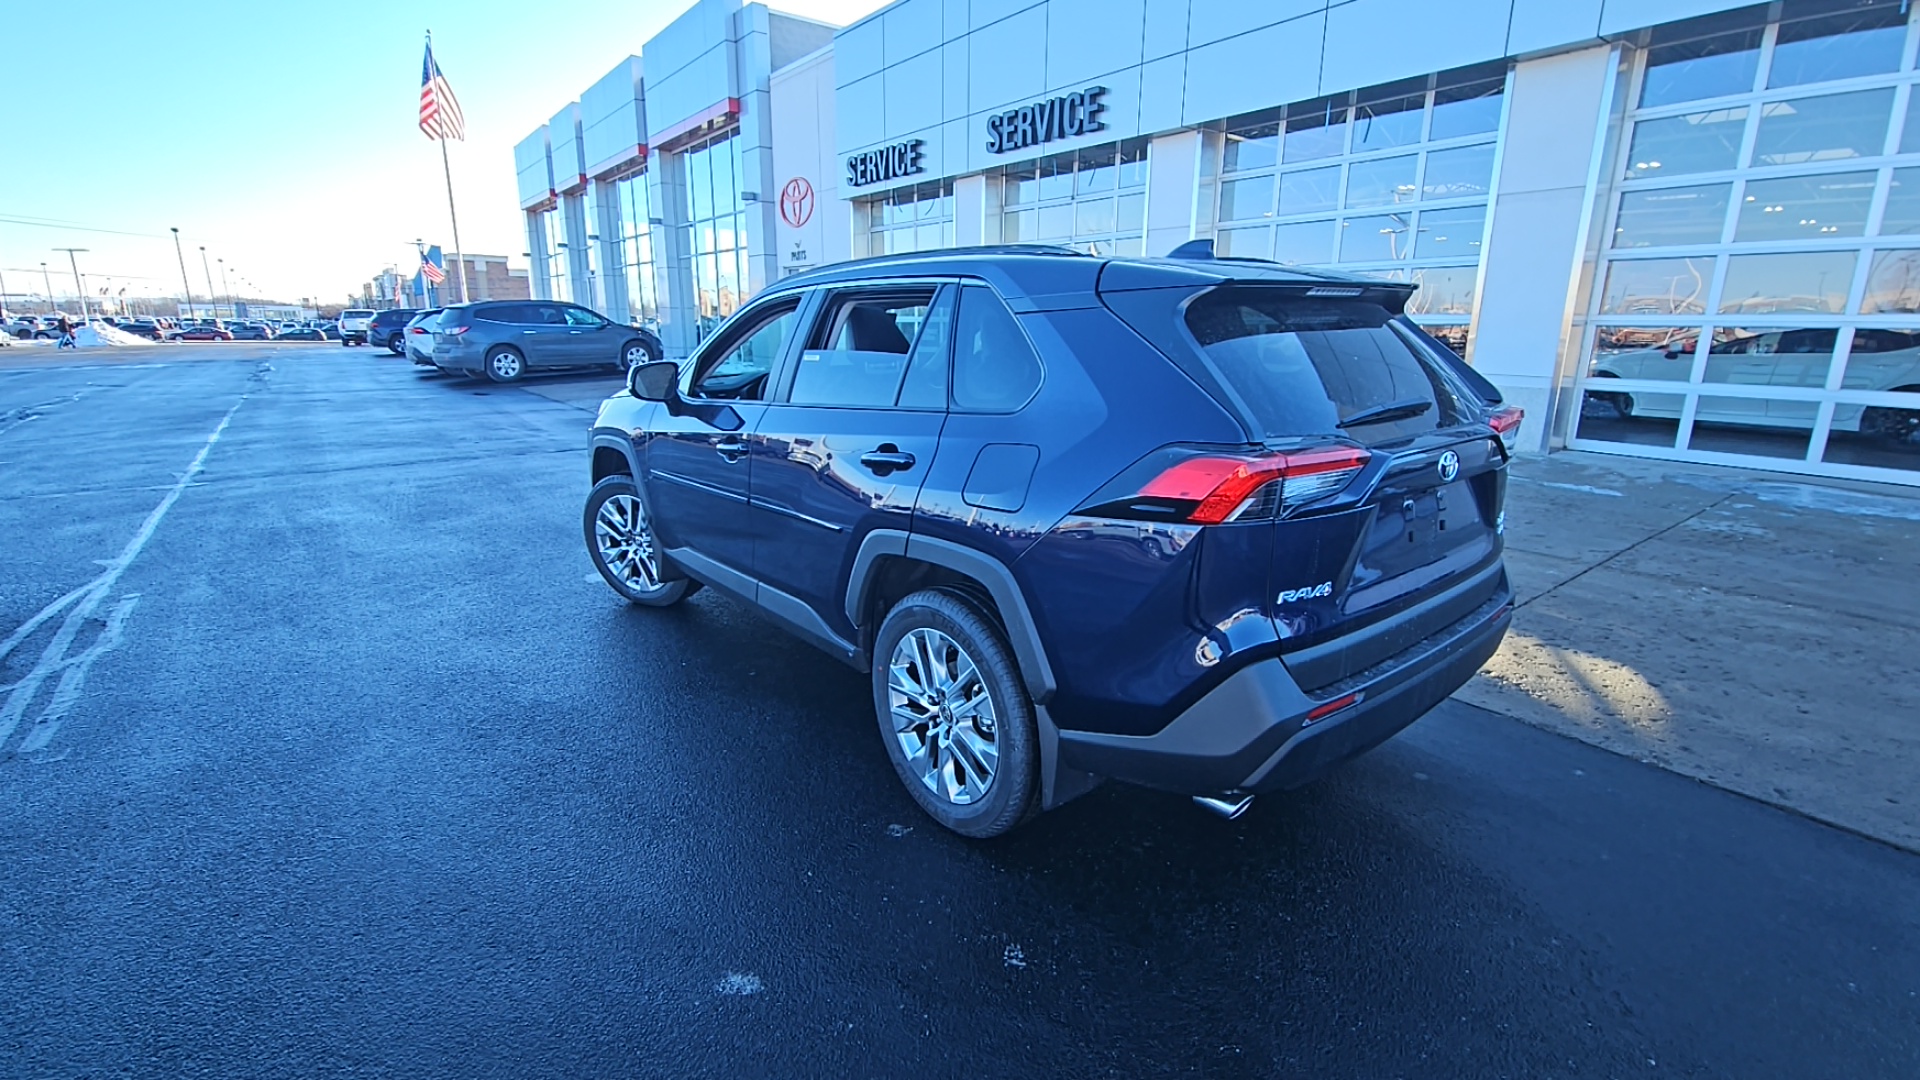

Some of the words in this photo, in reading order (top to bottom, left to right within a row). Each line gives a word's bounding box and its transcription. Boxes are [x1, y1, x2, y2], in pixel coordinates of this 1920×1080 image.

[985, 86, 1109, 154] SERVICE
[846, 138, 925, 187] SERVICE
[1276, 581, 1332, 605] RAV4
